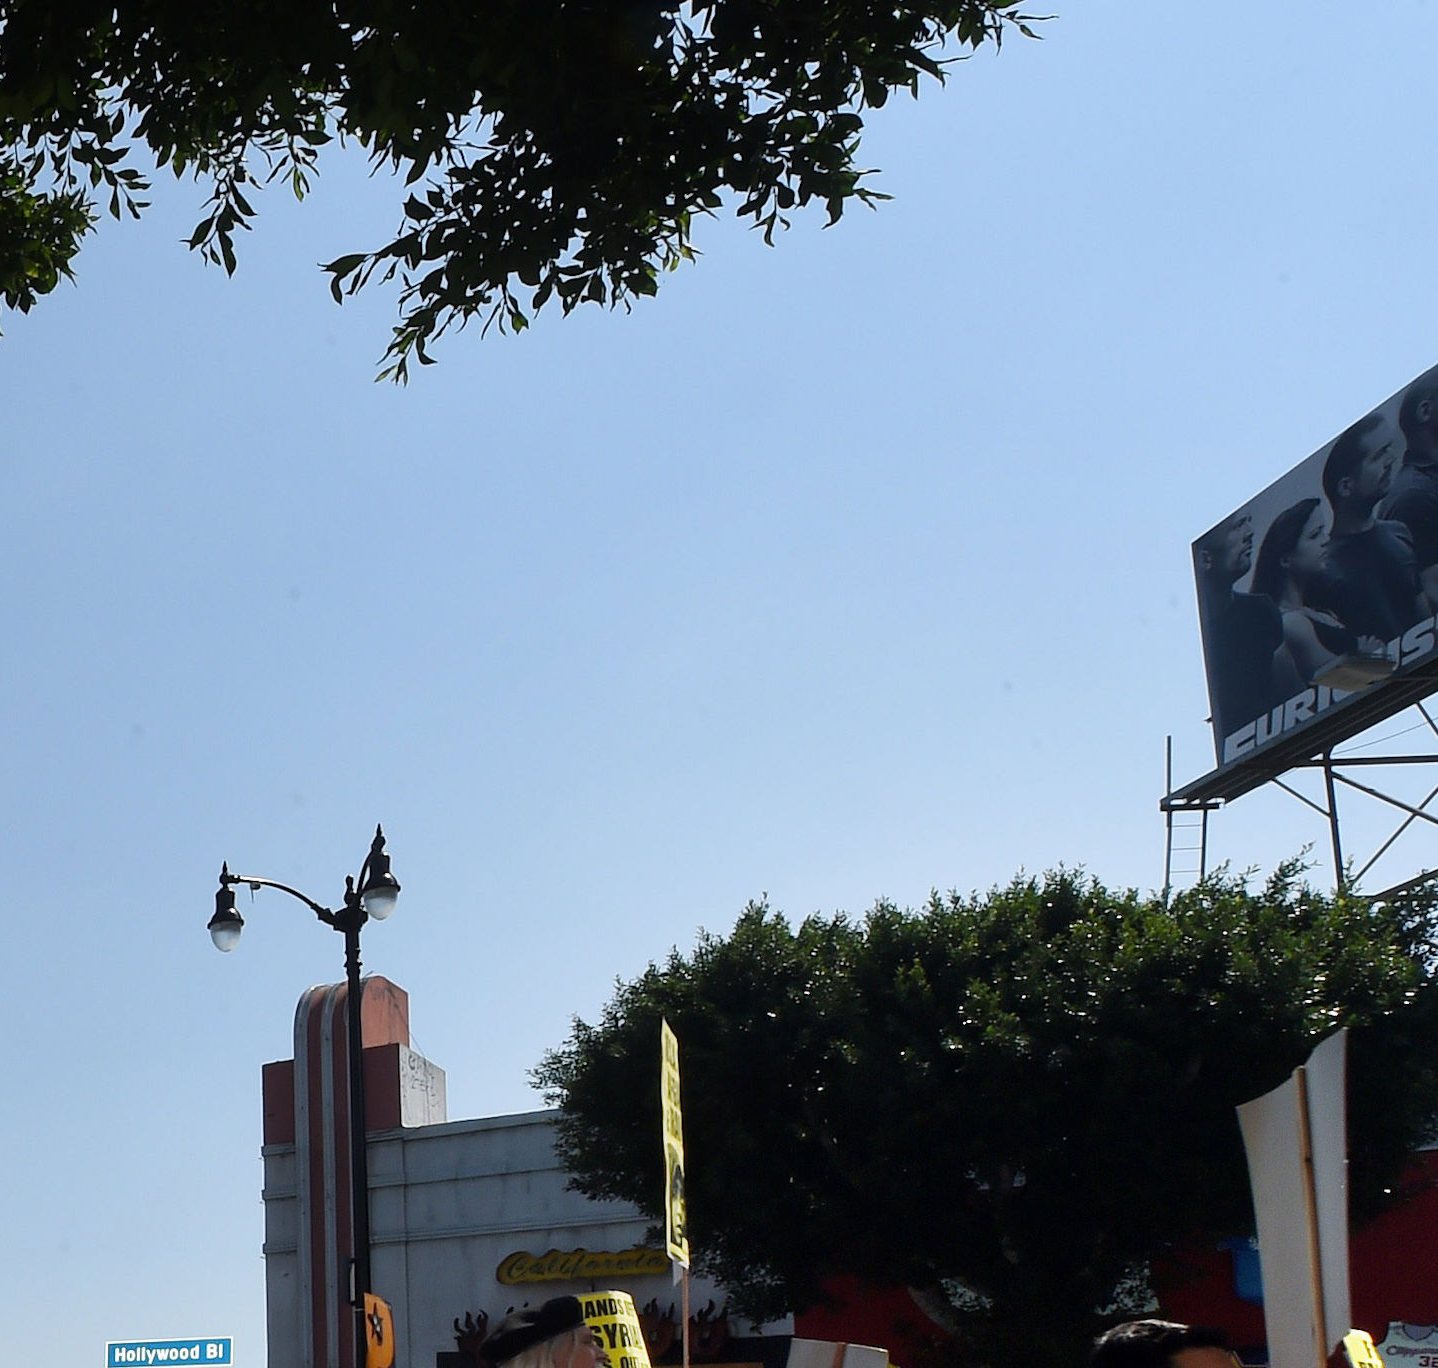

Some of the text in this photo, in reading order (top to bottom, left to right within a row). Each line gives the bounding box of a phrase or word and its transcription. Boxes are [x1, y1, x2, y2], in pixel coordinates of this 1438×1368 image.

[582, 1298, 624, 1319] ANDS
[114, 1343, 224, 1365] Hollywood Bl
